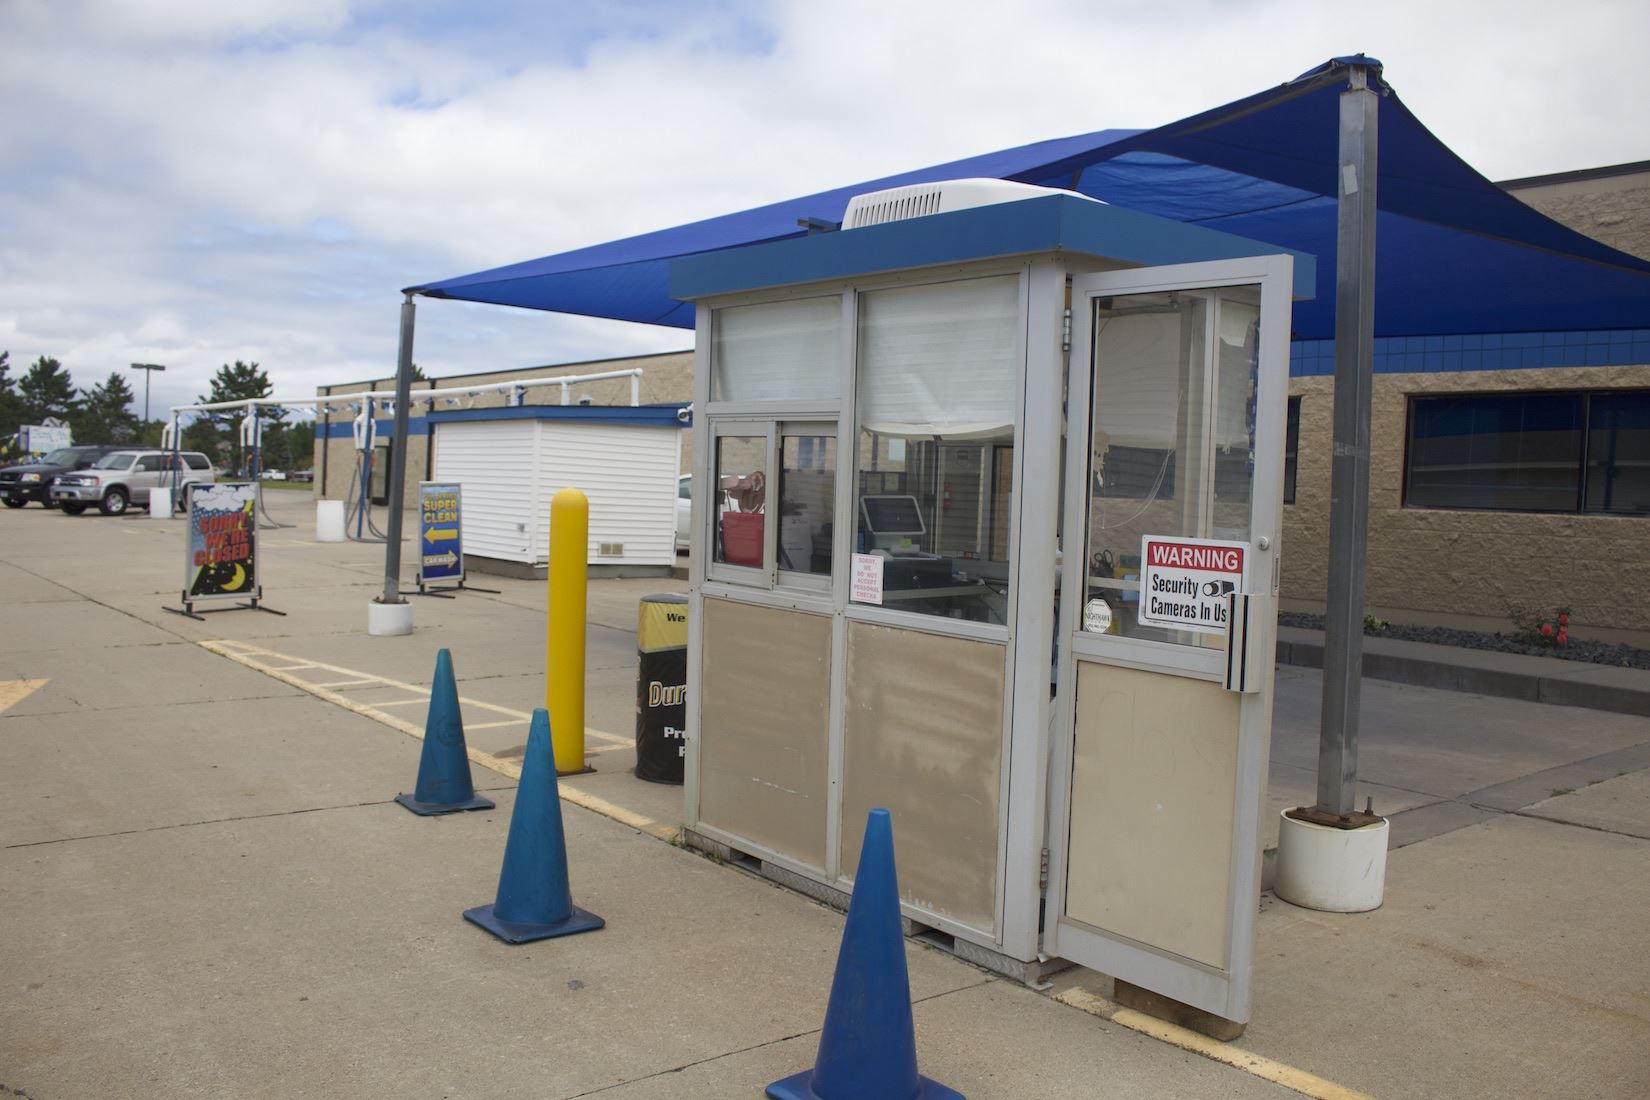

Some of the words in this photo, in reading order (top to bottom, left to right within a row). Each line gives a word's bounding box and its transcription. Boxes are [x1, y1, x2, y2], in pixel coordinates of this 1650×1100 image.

[423, 499, 457, 512] SUPER
[198, 511, 249, 534] SORRY
[423, 511, 458, 524] CLEAN
[193, 542, 250, 567] CLOSED
[1152, 545, 1239, 571] WARNING
[854, 583, 880, 592] PERSONAL
[856, 591, 877, 599] CHECKS
[1152, 573, 1199, 599] Security
[666, 613, 686, 623] We
[1151, 596, 1197, 619] Cameras
[1200, 602, 1210, 620] In
[1214, 603, 1227, 622] Us
[648, 681, 687, 708] Dur
[663, 726, 687, 739] Pr
